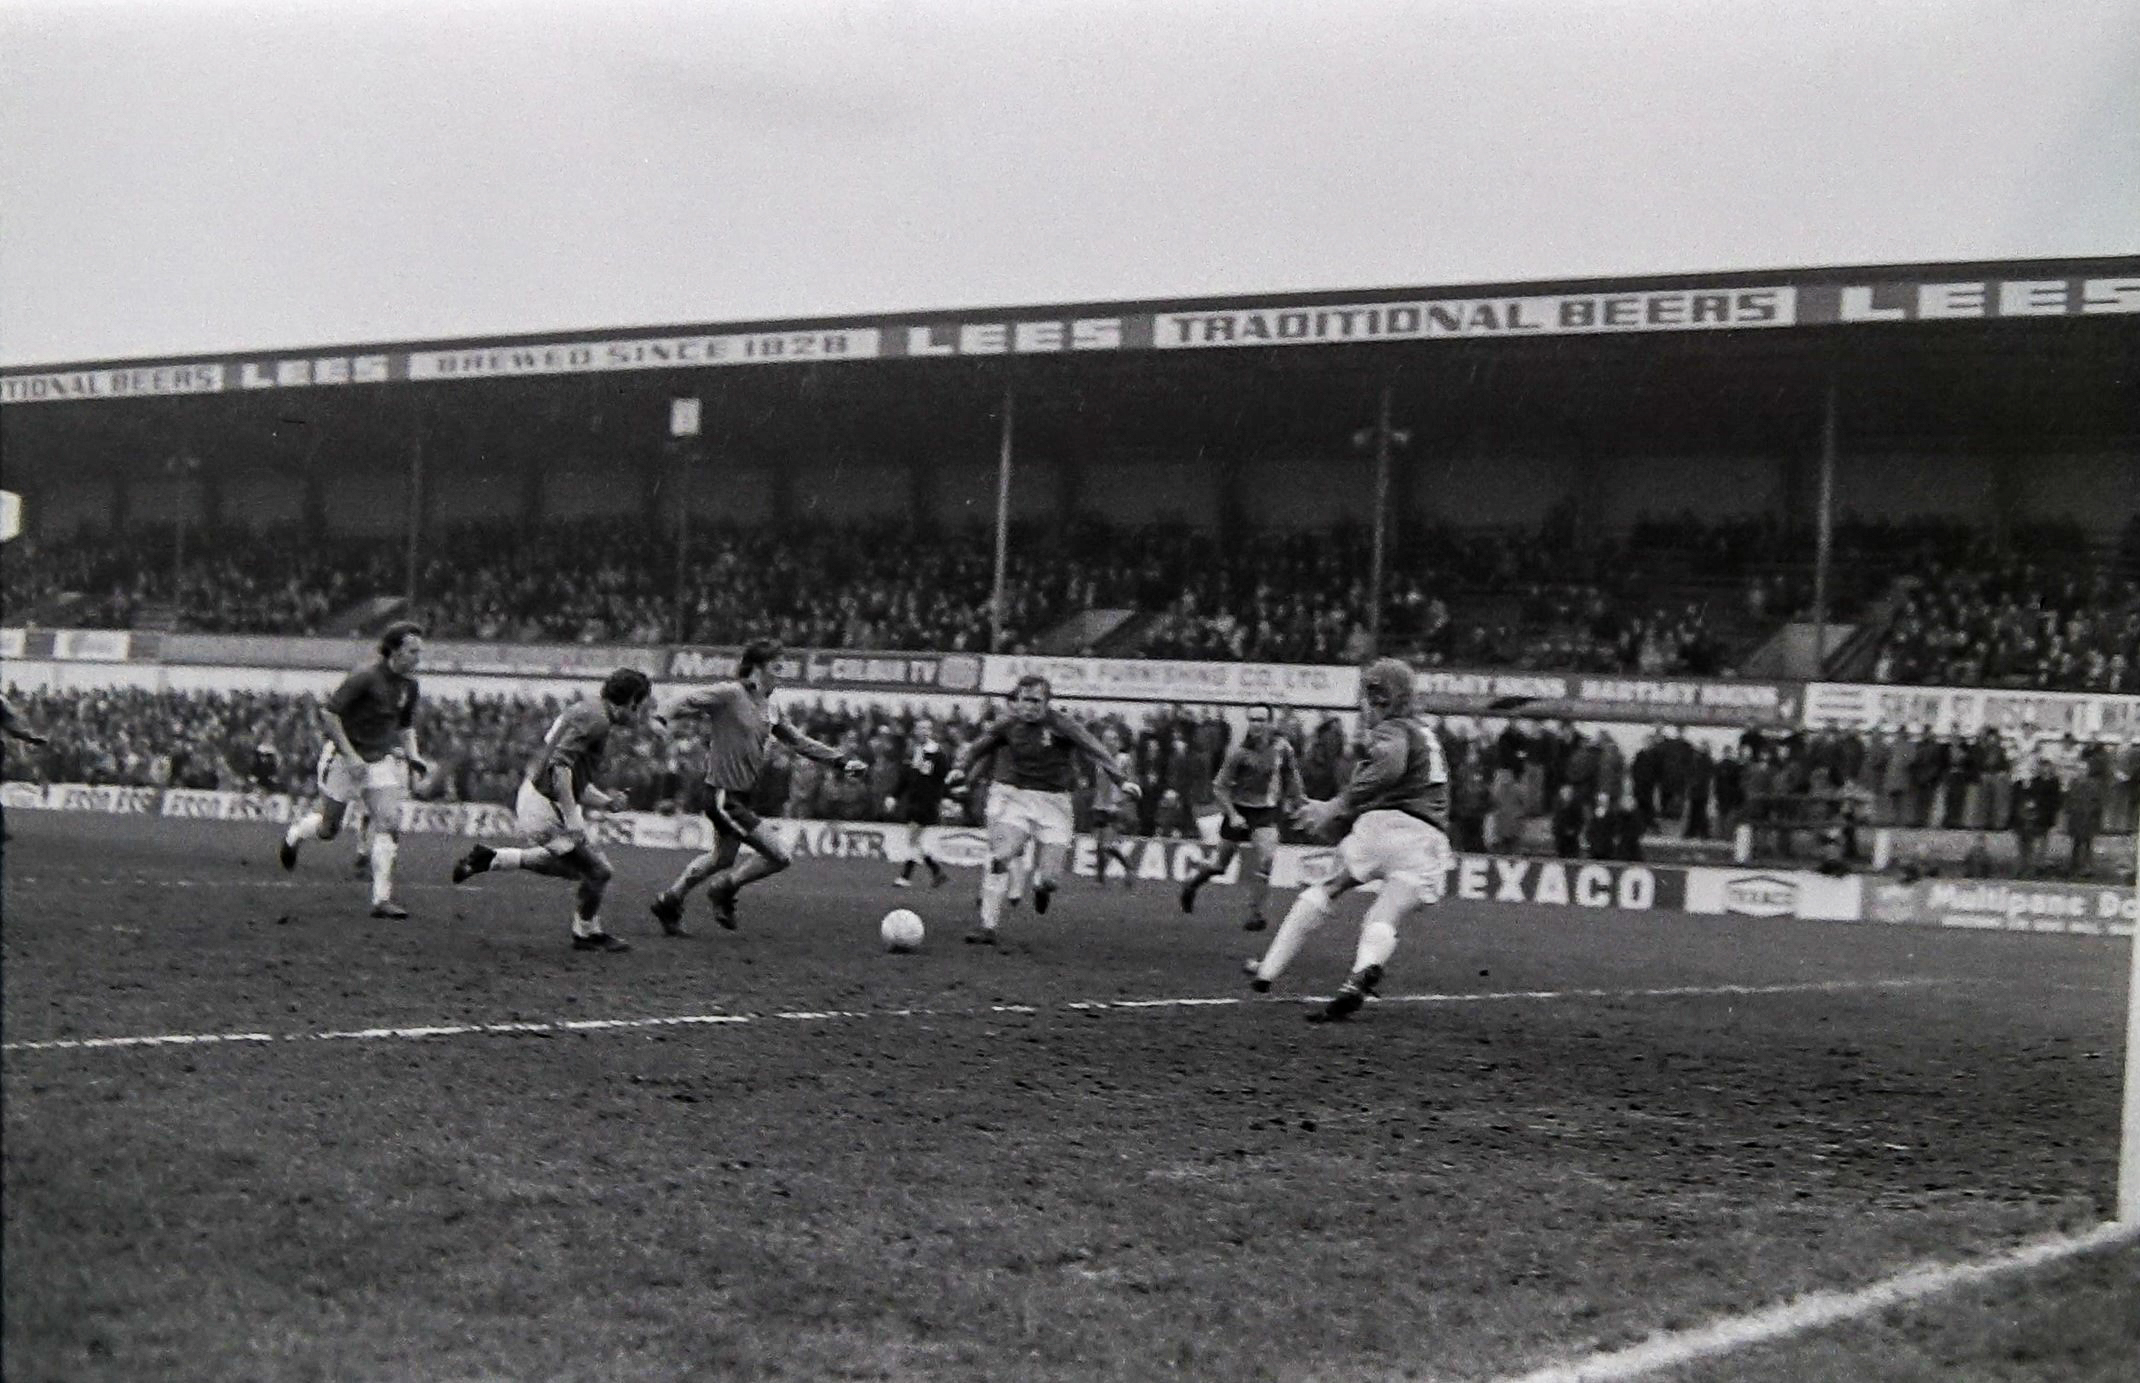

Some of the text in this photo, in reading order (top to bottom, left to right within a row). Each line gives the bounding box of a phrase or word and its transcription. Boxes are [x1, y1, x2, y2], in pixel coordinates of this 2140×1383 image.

[1171, 293, 1777, 343] TRADITIONAL BEERS
[1841, 278, 2140, 322] LEES
[437, 335, 848, 373] BREWED SINCE 1828
[906, 317, 1121, 356] LEES
[110, 362, 214, 392] BEERS
[241, 355, 389, 389] LEES
